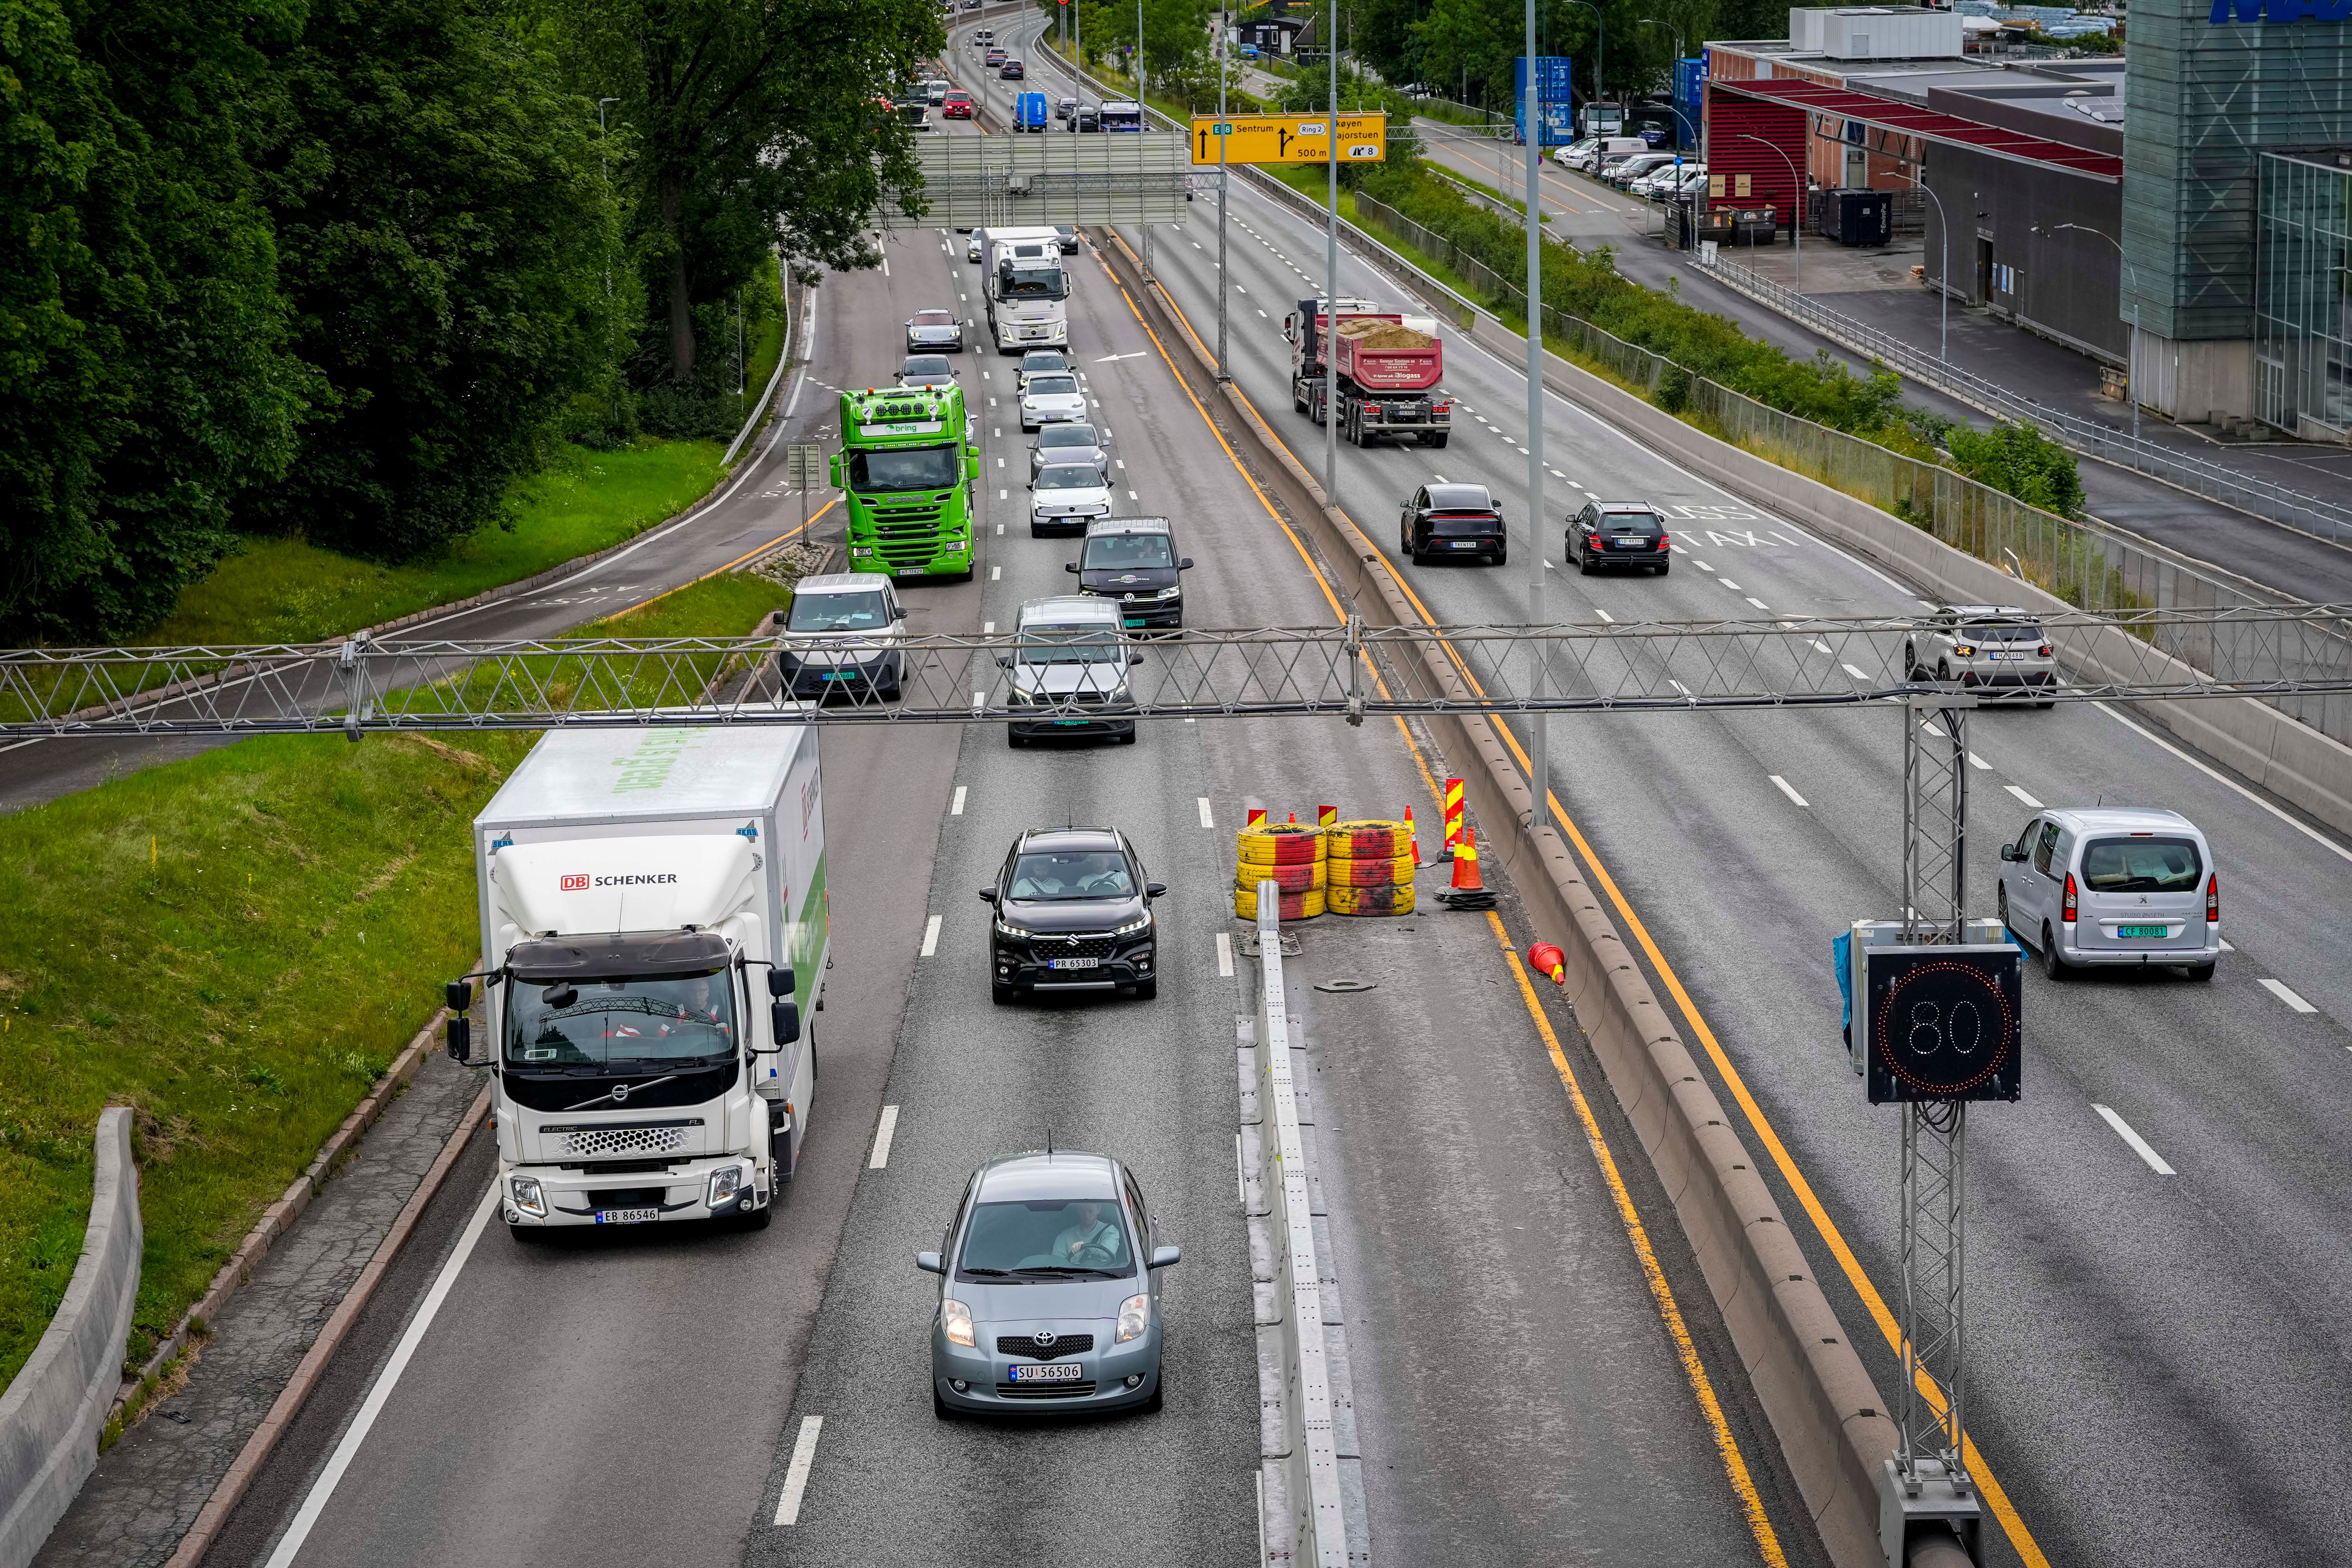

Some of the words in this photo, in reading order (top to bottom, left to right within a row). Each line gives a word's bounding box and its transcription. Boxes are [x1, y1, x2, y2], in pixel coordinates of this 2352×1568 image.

[1336, 120, 1362, 129] køyen
[1337, 132, 1378, 140] ajorstuen
[895, 424, 917, 432] bring
[886, 495, 926, 504] SCANIA
[1667, 530, 1800, 546] TAXI
[807, 766, 820, 822] SCHENKER
[492, 840, 514, 849] SKAB
[564, 878, 586, 887] DB
[595, 874, 677, 886] SCHENKER
[1070, 959, 1096, 967] 65303
[1909, 1001, 1980, 1054] 80
[605, 1212, 618, 1221] EB
[622, 1210, 656, 1220] 86546
[1019, 1367, 1033, 1378] SU
[1041, 1366, 1078, 1377] 56506
